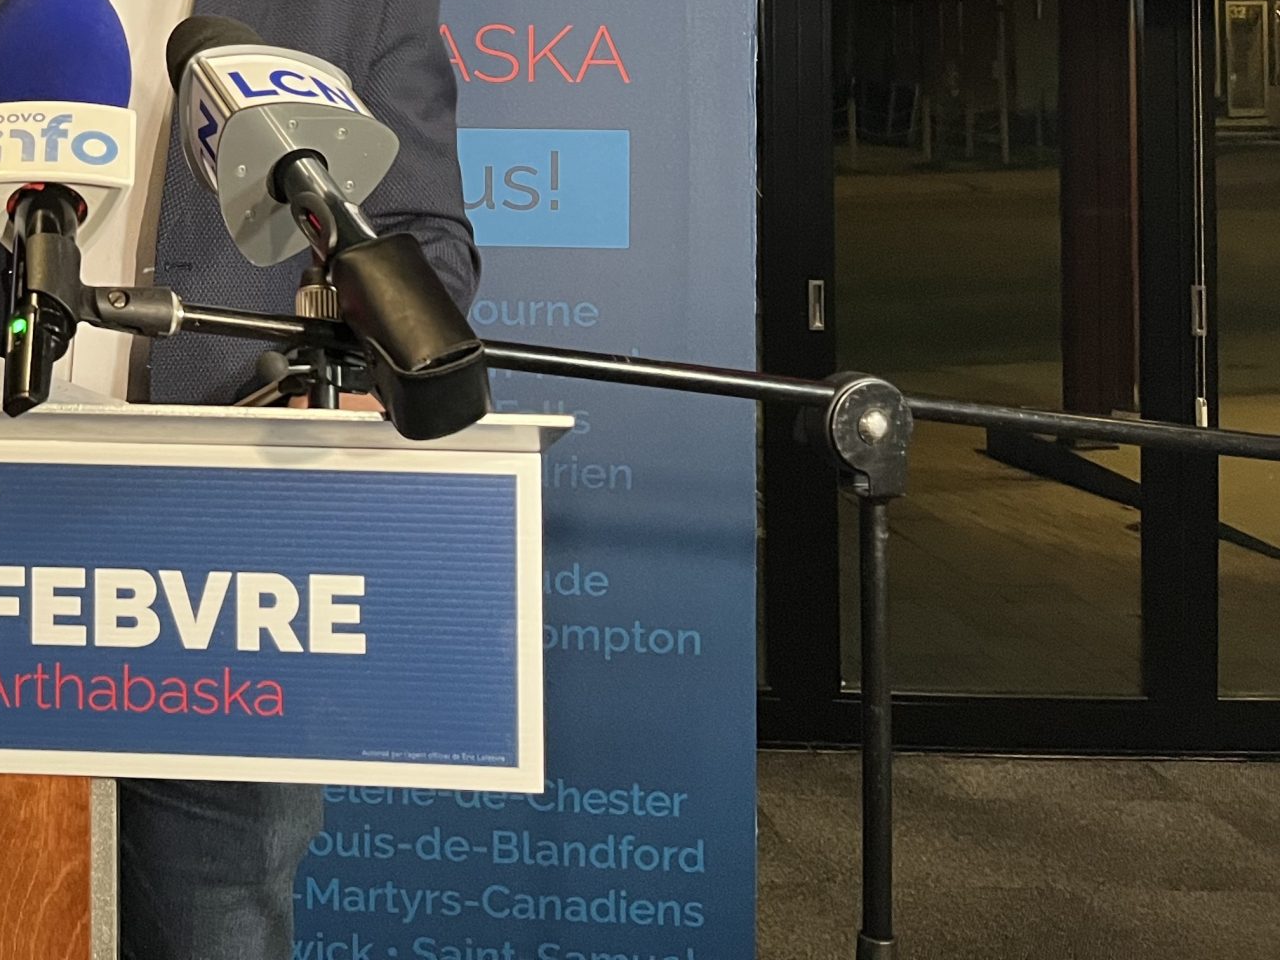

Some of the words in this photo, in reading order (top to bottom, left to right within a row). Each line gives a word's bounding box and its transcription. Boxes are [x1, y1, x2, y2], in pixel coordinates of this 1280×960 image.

[227, 70, 361, 113] LCN
[472, 299, 600, 328] ourne
[308, 823, 706, 874] ouis-de-Blandford
